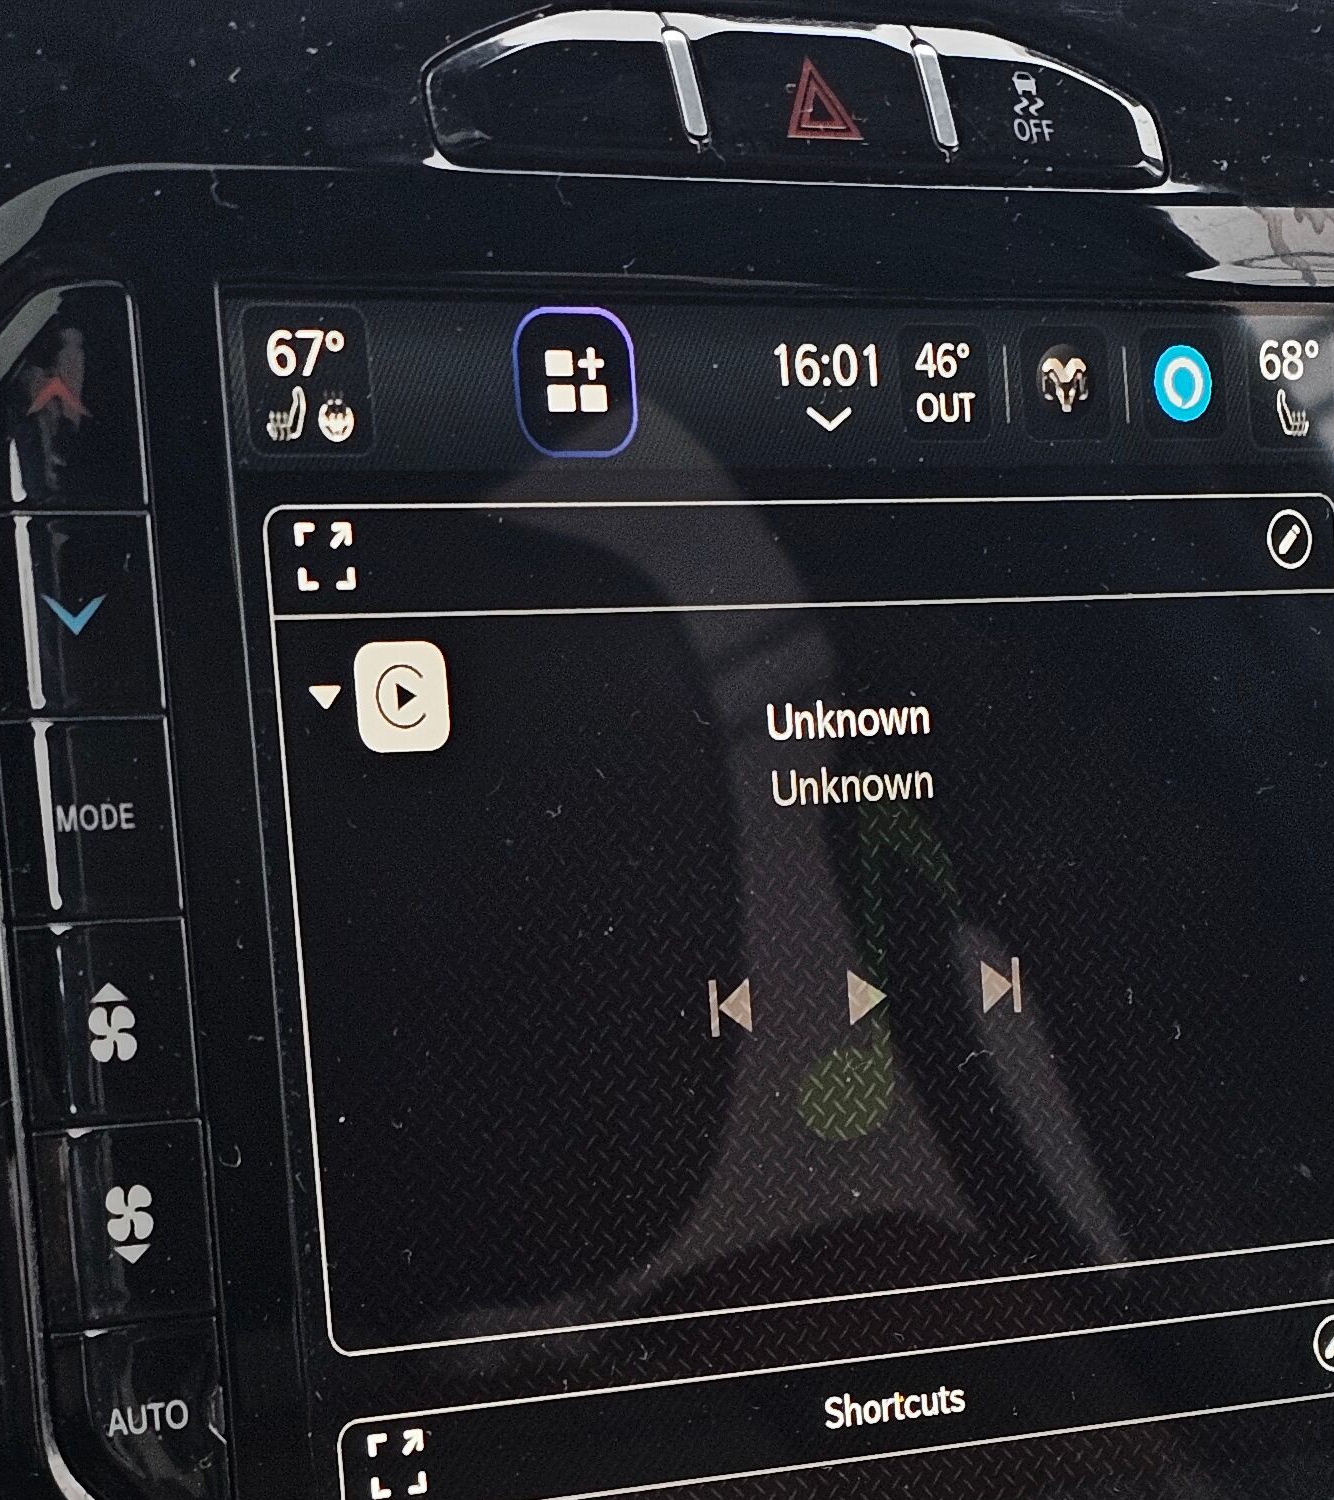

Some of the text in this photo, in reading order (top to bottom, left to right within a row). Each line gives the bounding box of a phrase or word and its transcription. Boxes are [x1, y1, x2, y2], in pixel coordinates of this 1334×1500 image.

[1013, 118, 1055, 143] OFF
[266, 329, 345, 377] 67°
[773, 342, 878, 388] 16:01
[914, 341, 970, 379] 46°
[1259, 338, 1319, 381] 68°
[916, 391, 976, 423] OUT
[766, 699, 931, 741] Unknown
[771, 766, 934, 807] Unknown
[56, 802, 136, 833] MODE
[106, 1399, 189, 1438] AUTO
[824, 1385, 966, 1430] Shortcuts
